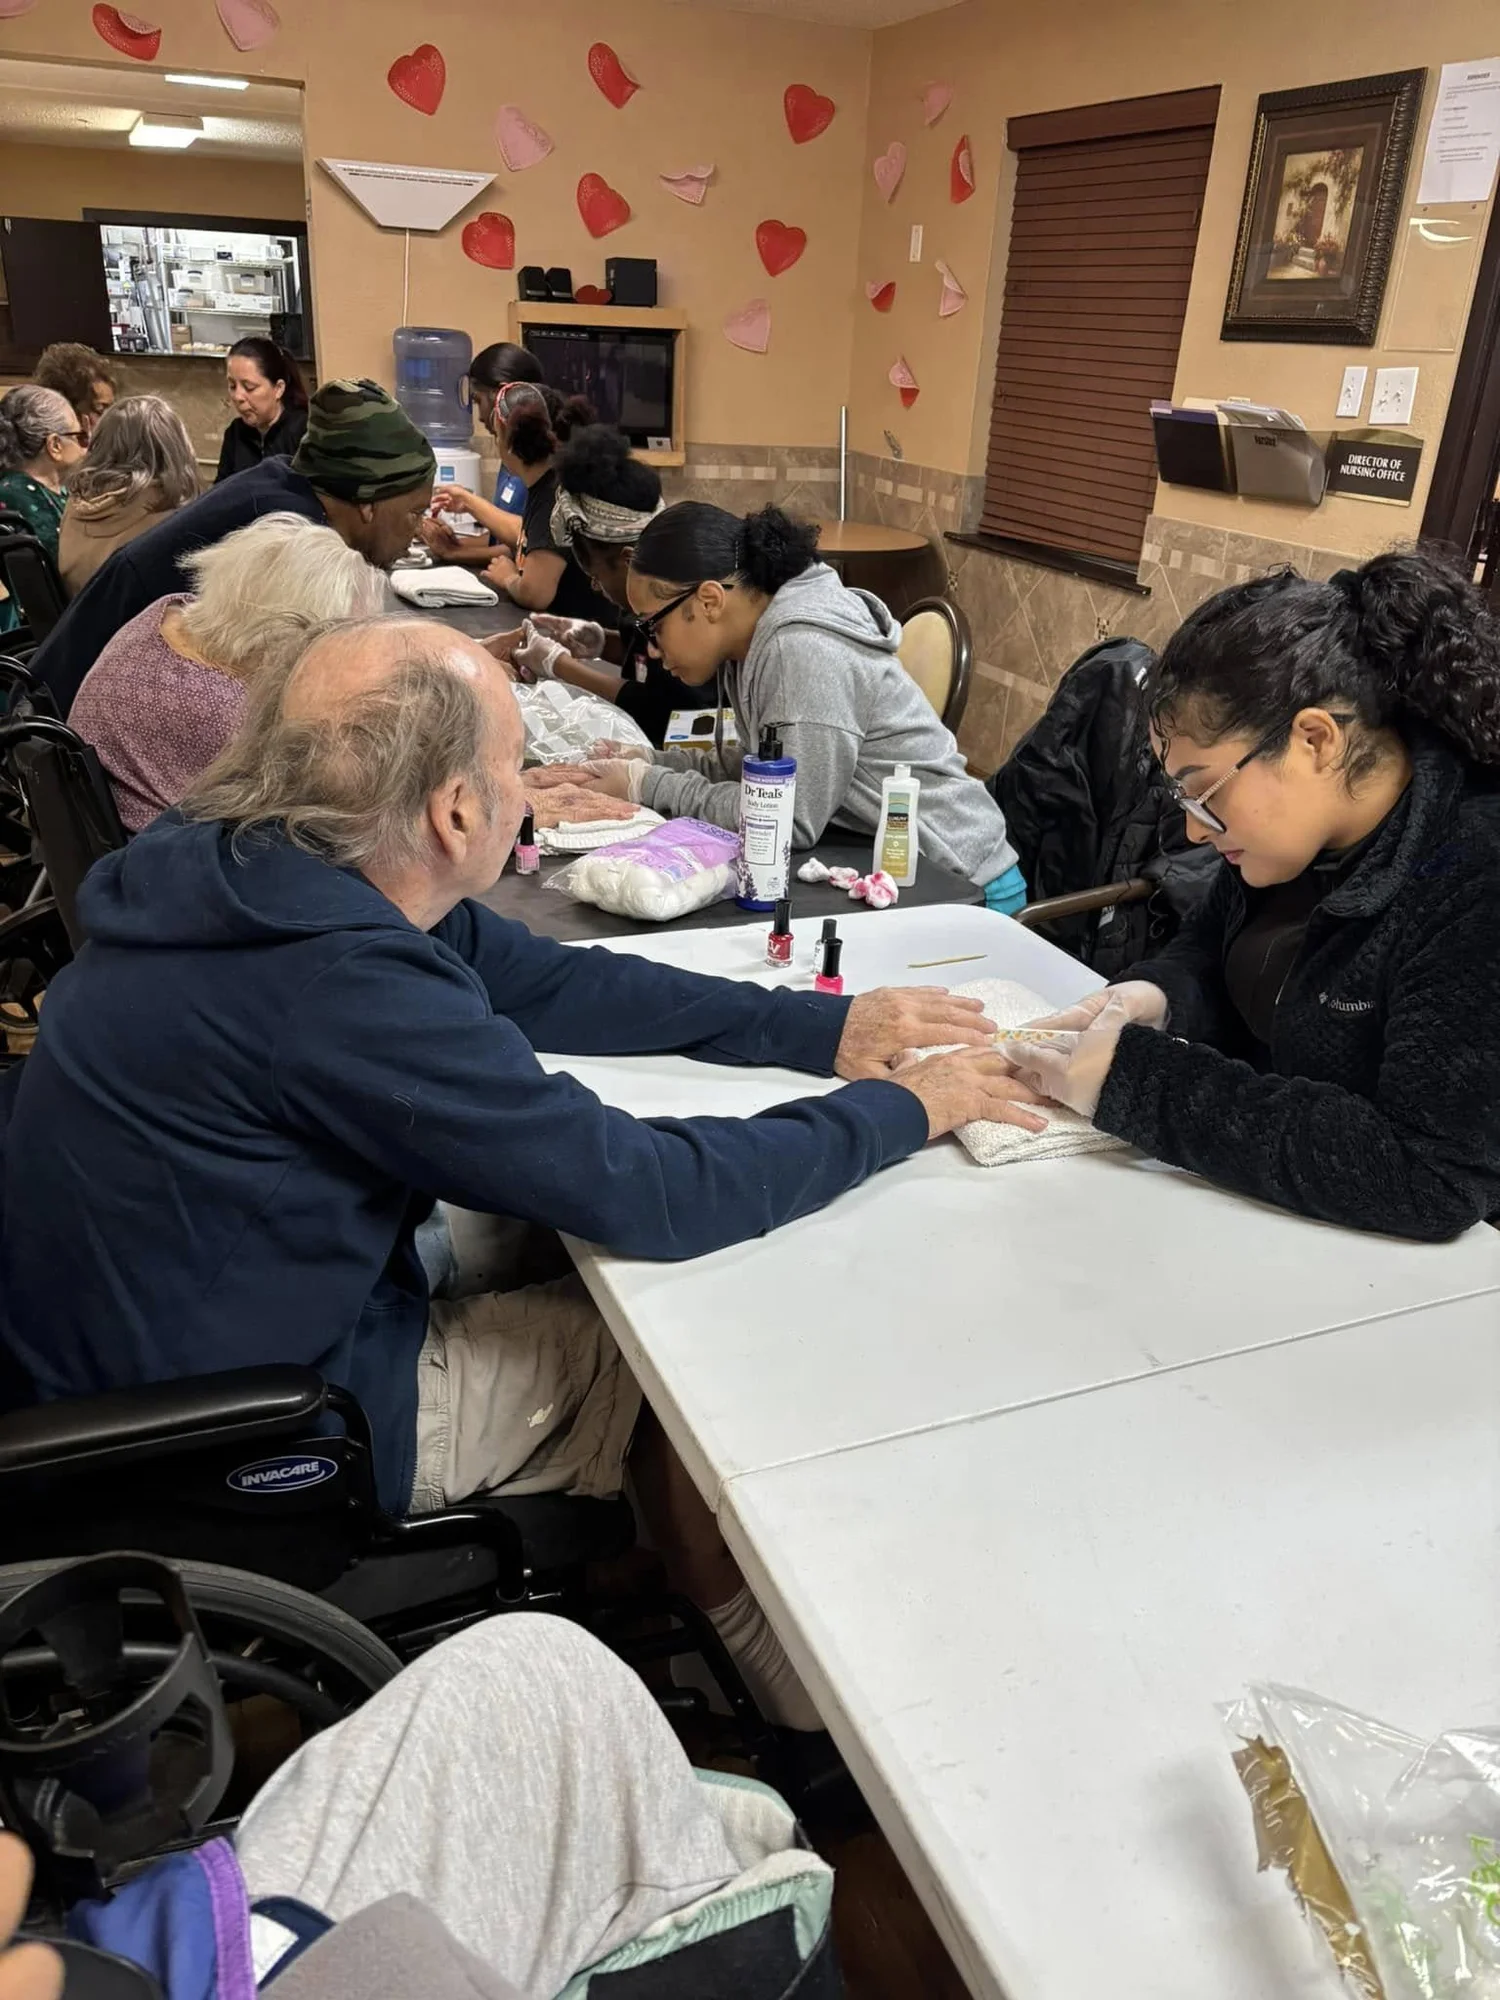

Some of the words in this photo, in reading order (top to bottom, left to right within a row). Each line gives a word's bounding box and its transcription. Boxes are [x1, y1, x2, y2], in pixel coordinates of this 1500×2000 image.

[1348, 454, 1389, 468] DIRECTOR
[1390, 459, 1403, 470] OF
[1340, 464, 1376, 478] NURSING
[1376, 468, 1407, 482] OFFICE
[744, 784, 756, 797] Dr
[756, 787, 783, 799] Teal's
[241, 1461, 320, 1487] INVACARE
